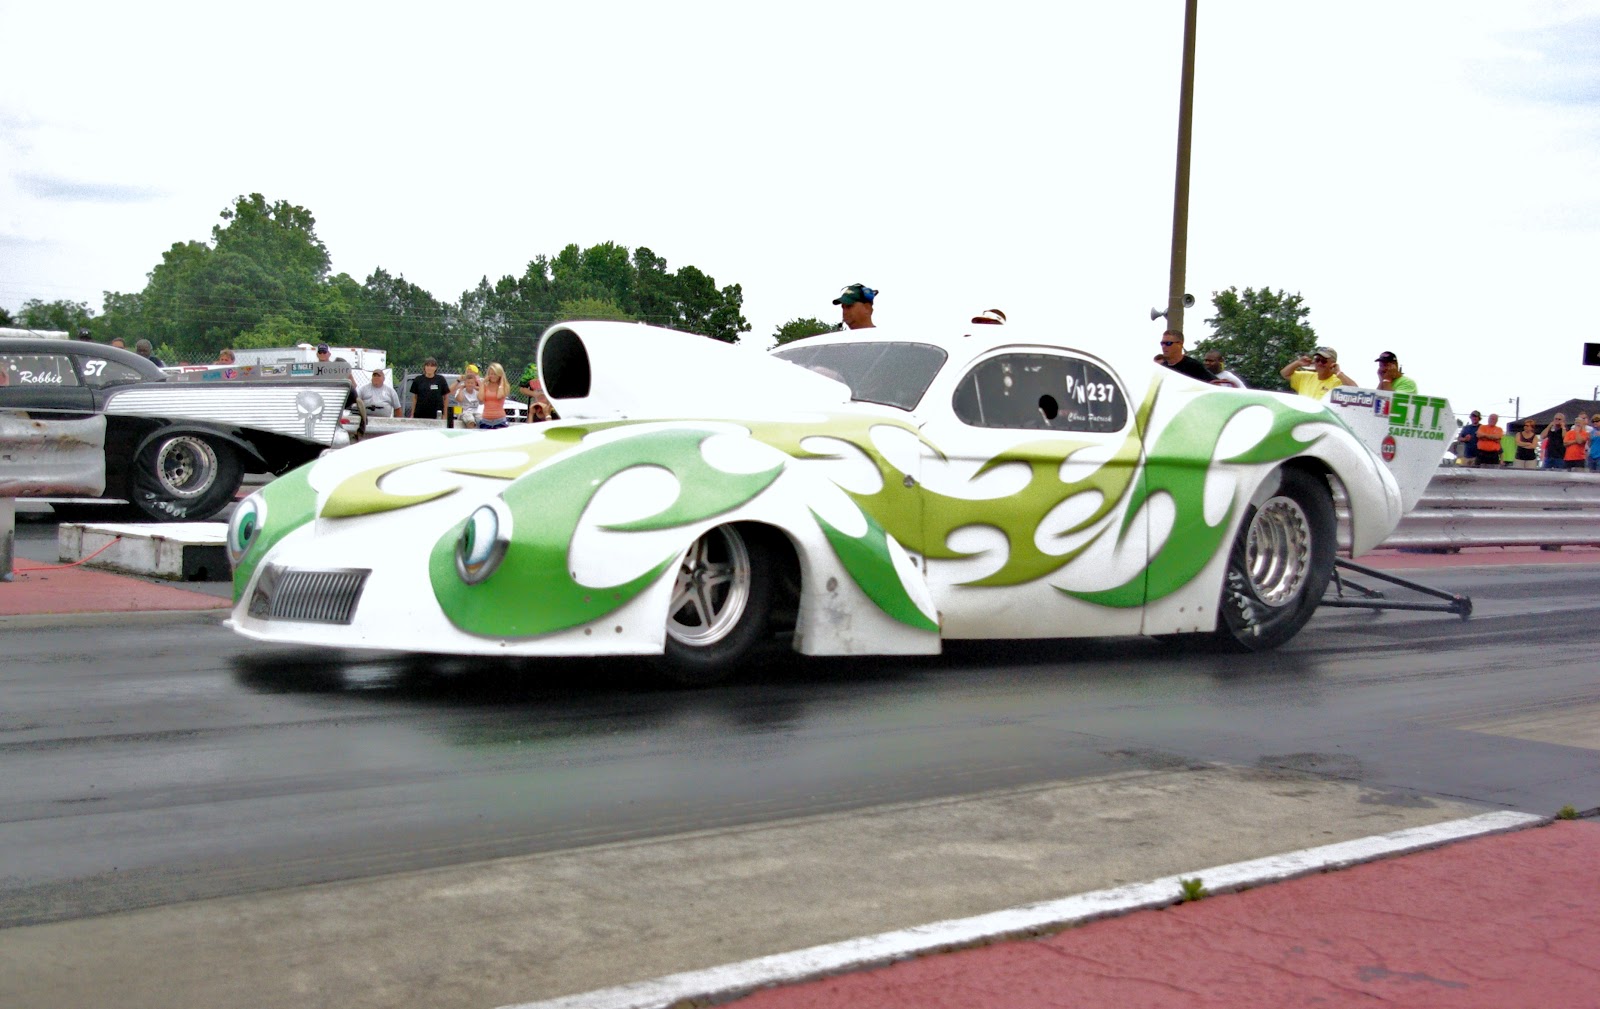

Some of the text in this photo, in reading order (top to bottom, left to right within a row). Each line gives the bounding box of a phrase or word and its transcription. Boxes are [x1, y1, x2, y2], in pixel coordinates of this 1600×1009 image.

[83, 360, 107, 376] 57
[316, 365, 350, 376] Hoosier
[19, 371, 63, 384] Robbie
[1086, 382, 1114, 403] 237
[1388, 426, 1445, 441] SAFETY.COM
